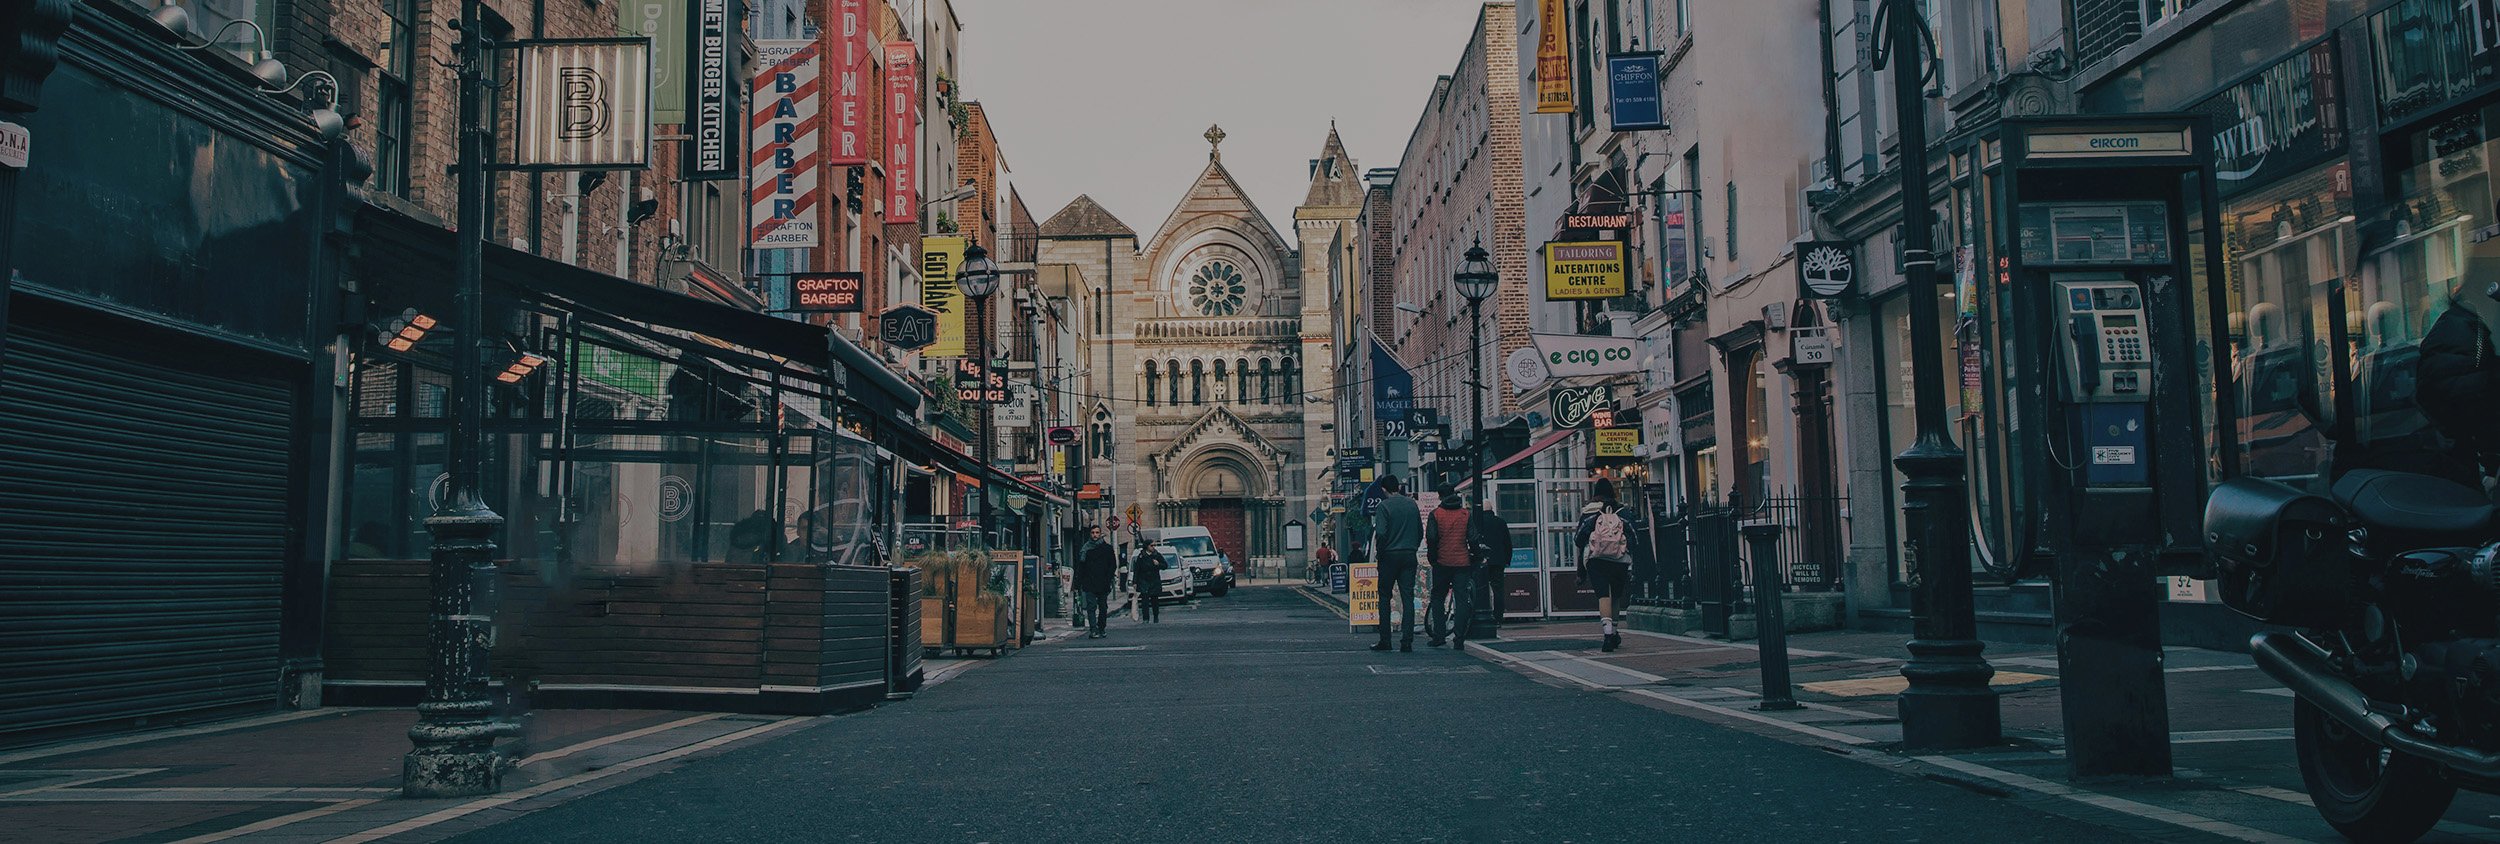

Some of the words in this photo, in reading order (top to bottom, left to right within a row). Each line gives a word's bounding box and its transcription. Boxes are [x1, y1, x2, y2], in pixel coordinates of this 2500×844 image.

[1545, 0, 1556, 52] ATION
[760, 48, 768, 66] THE
[768, 47, 814, 56] GRAFTON
[769, 58, 810, 66] BARBER
[704, 36, 722, 98] BURGER
[1540, 59, 1567, 79] CENTRE
[842, 12, 856, 156] DINER
[1614, 72, 1653, 81] CHIFFON
[559, 66, 608, 140] B
[702, 103, 720, 171] KITCHEN
[774, 72, 798, 220] BARBER
[2090, 136, 2138, 149] eircom
[894, 92, 908, 217] DINER
[766, 222, 812, 230] GRAFTON
[1568, 216, 1627, 228] RESTAURANT
[767, 234, 808, 242] BARBER
[1560, 248, 1612, 258] TAILORING
[1554, 264, 1620, 274] ALTERATIONS
[797, 279, 858, 290] GRAFTON
[1568, 276, 1606, 286] CENTRE
[801, 292, 854, 305] BARBER
[884, 316, 932, 342] EAT
[1550, 352, 1562, 364] e
[1567, 348, 1600, 366] cig
[1604, 346, 1632, 361] co
[1807, 351, 1822, 360] 30
[960, 360, 1004, 388] KEES
[1552, 386, 1606, 428] Cave
[1386, 420, 1407, 438] 22
[1594, 418, 1612, 427] BAR
[664, 486, 680, 512] B
